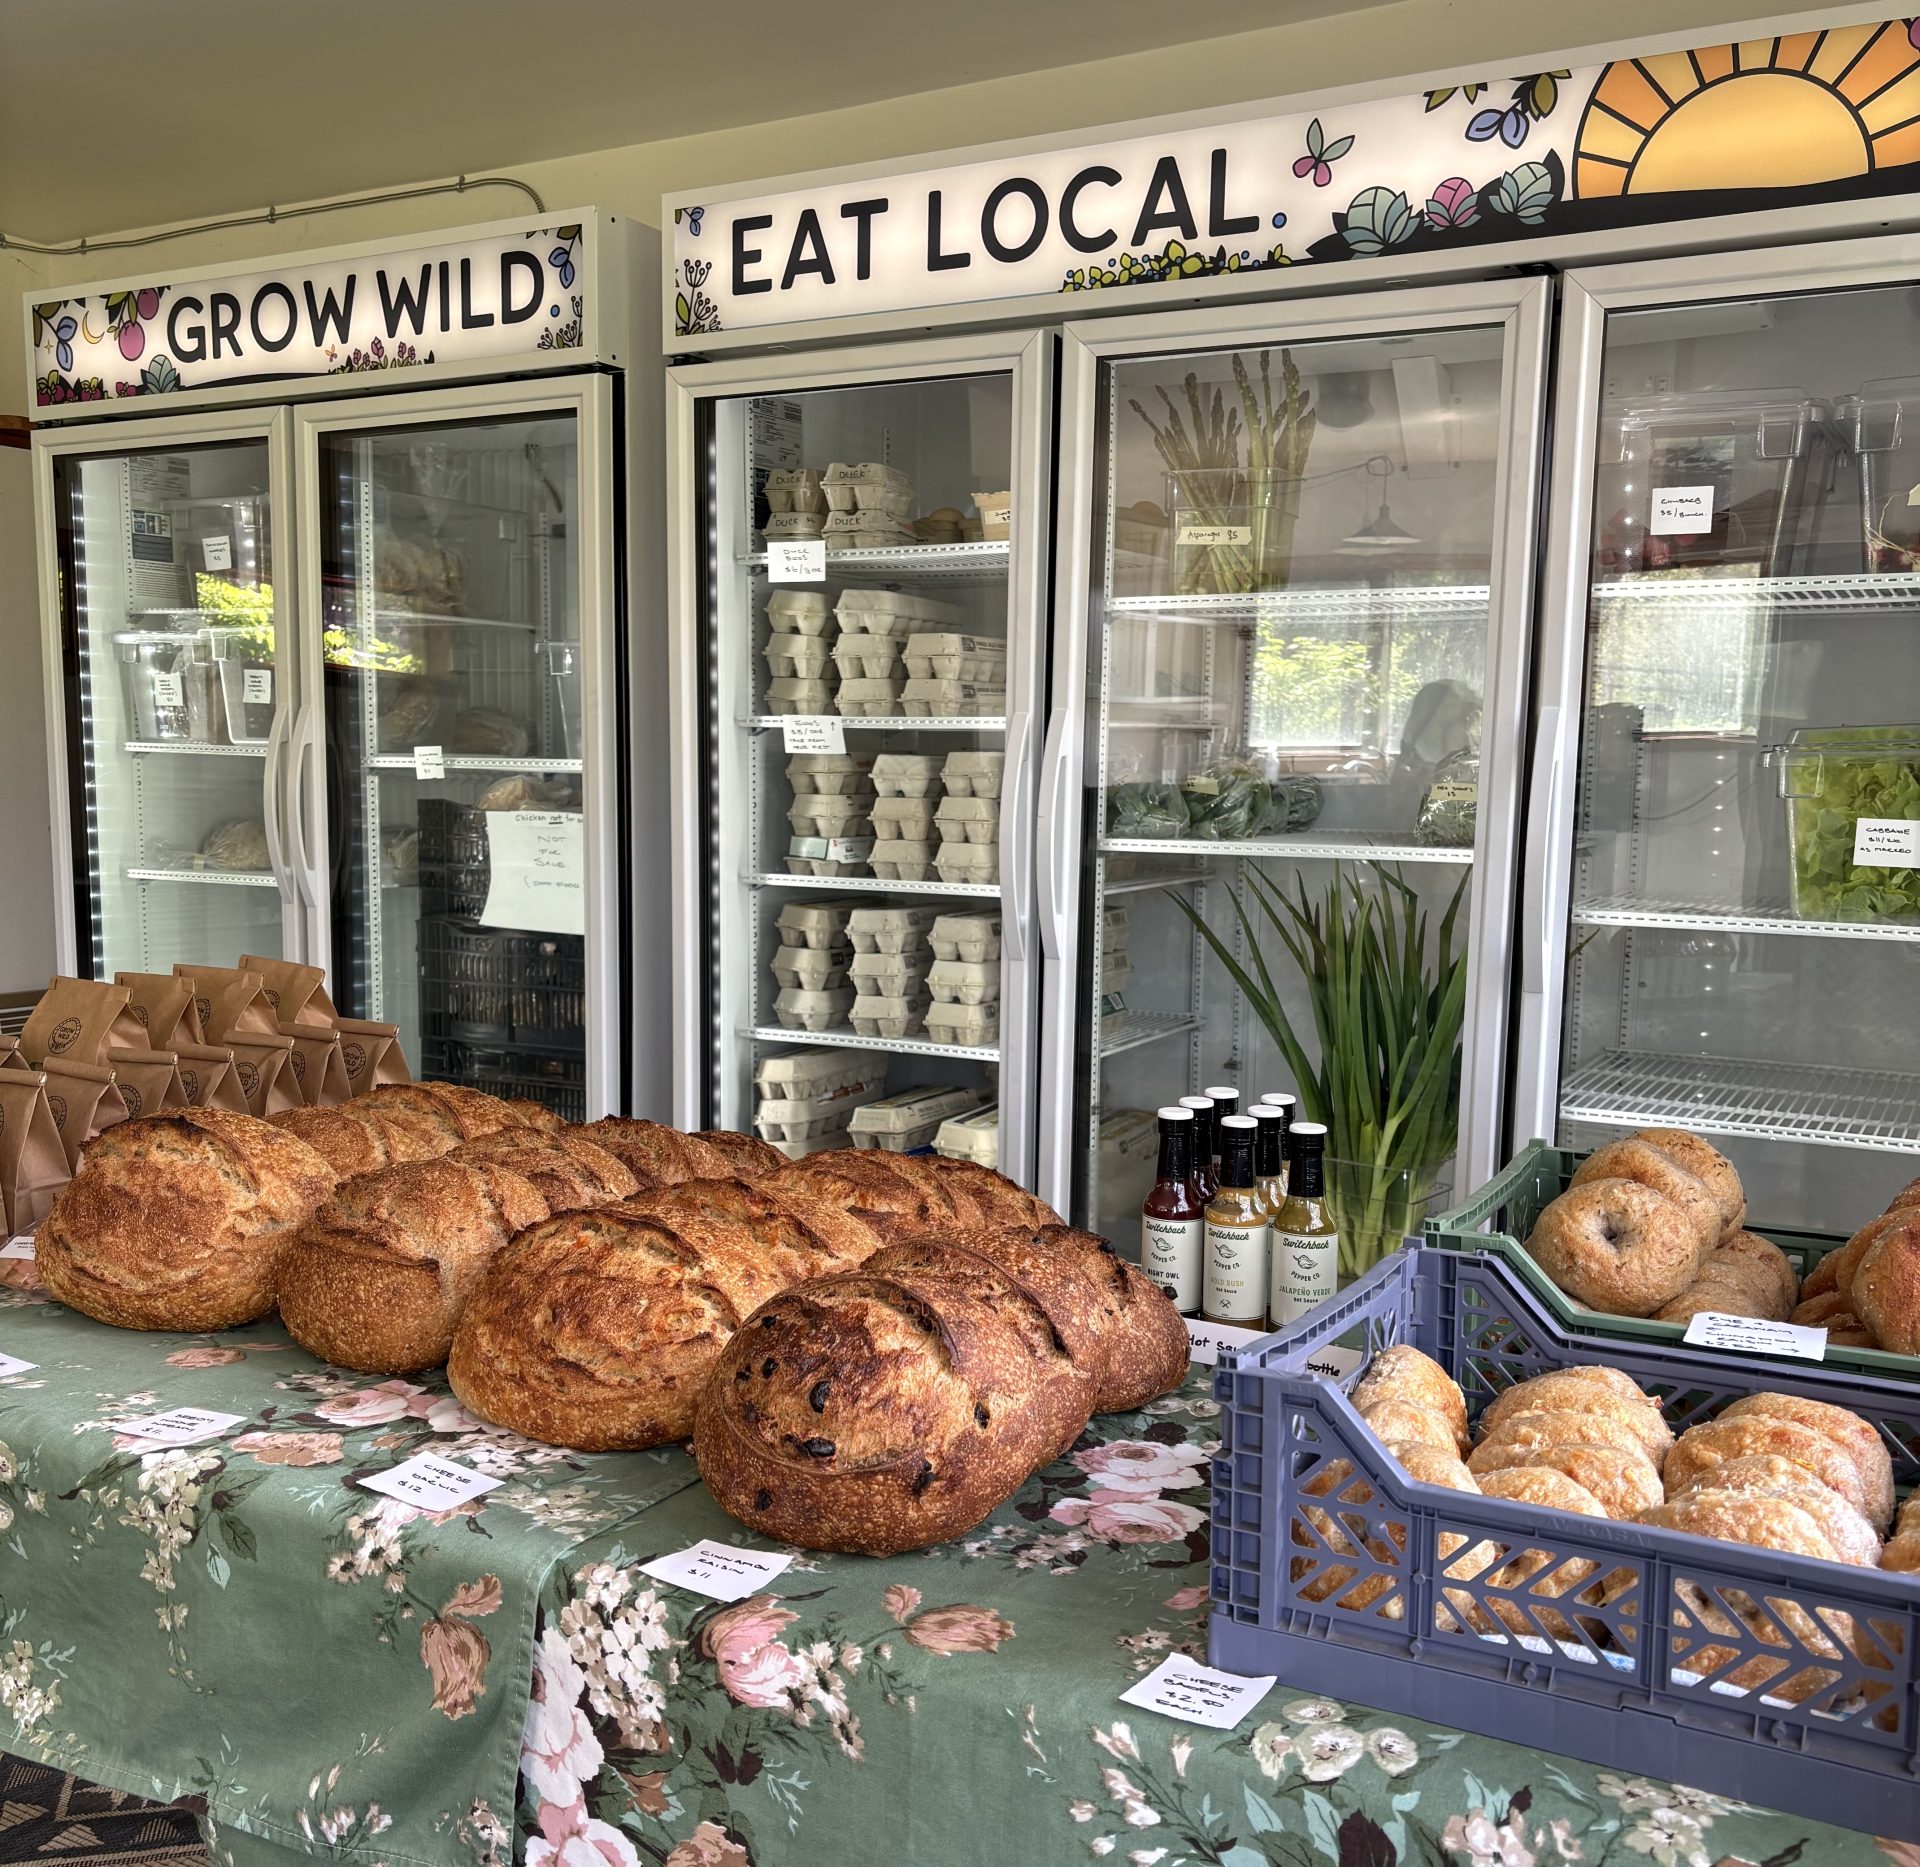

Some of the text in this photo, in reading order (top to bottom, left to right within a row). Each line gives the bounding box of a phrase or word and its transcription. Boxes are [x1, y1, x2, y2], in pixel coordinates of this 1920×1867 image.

[731, 197, 888, 296] EAT
[166, 273, 357, 364] GROW
[839, 470, 865, 479] DUCK
[775, 518, 798, 527] DUCK
[835, 517, 862, 526] DUCK
[1227, 529, 1238, 541] $5
[537, 834, 567, 843] NOT
[1208, 1227, 1250, 1241] Switchback
[1283, 1237, 1330, 1249] Switchback
[1213, 1259, 1231, 1270] PEPPER
[1290, 1270, 1311, 1282] PEPPER
[1279, 1285, 1331, 1297] JALAPEÑO VERDE
[1307, 1359, 1341, 1377] bottle
[424, 1464, 472, 1485] CHEESE
[398, 1480, 423, 1494] $12
[697, 1558, 744, 1575] RAISIN
[700, 1550, 770, 1571] CINNAMON
[687, 1569, 712, 1579] $11
[1172, 1673, 1245, 1694] CHEESE
